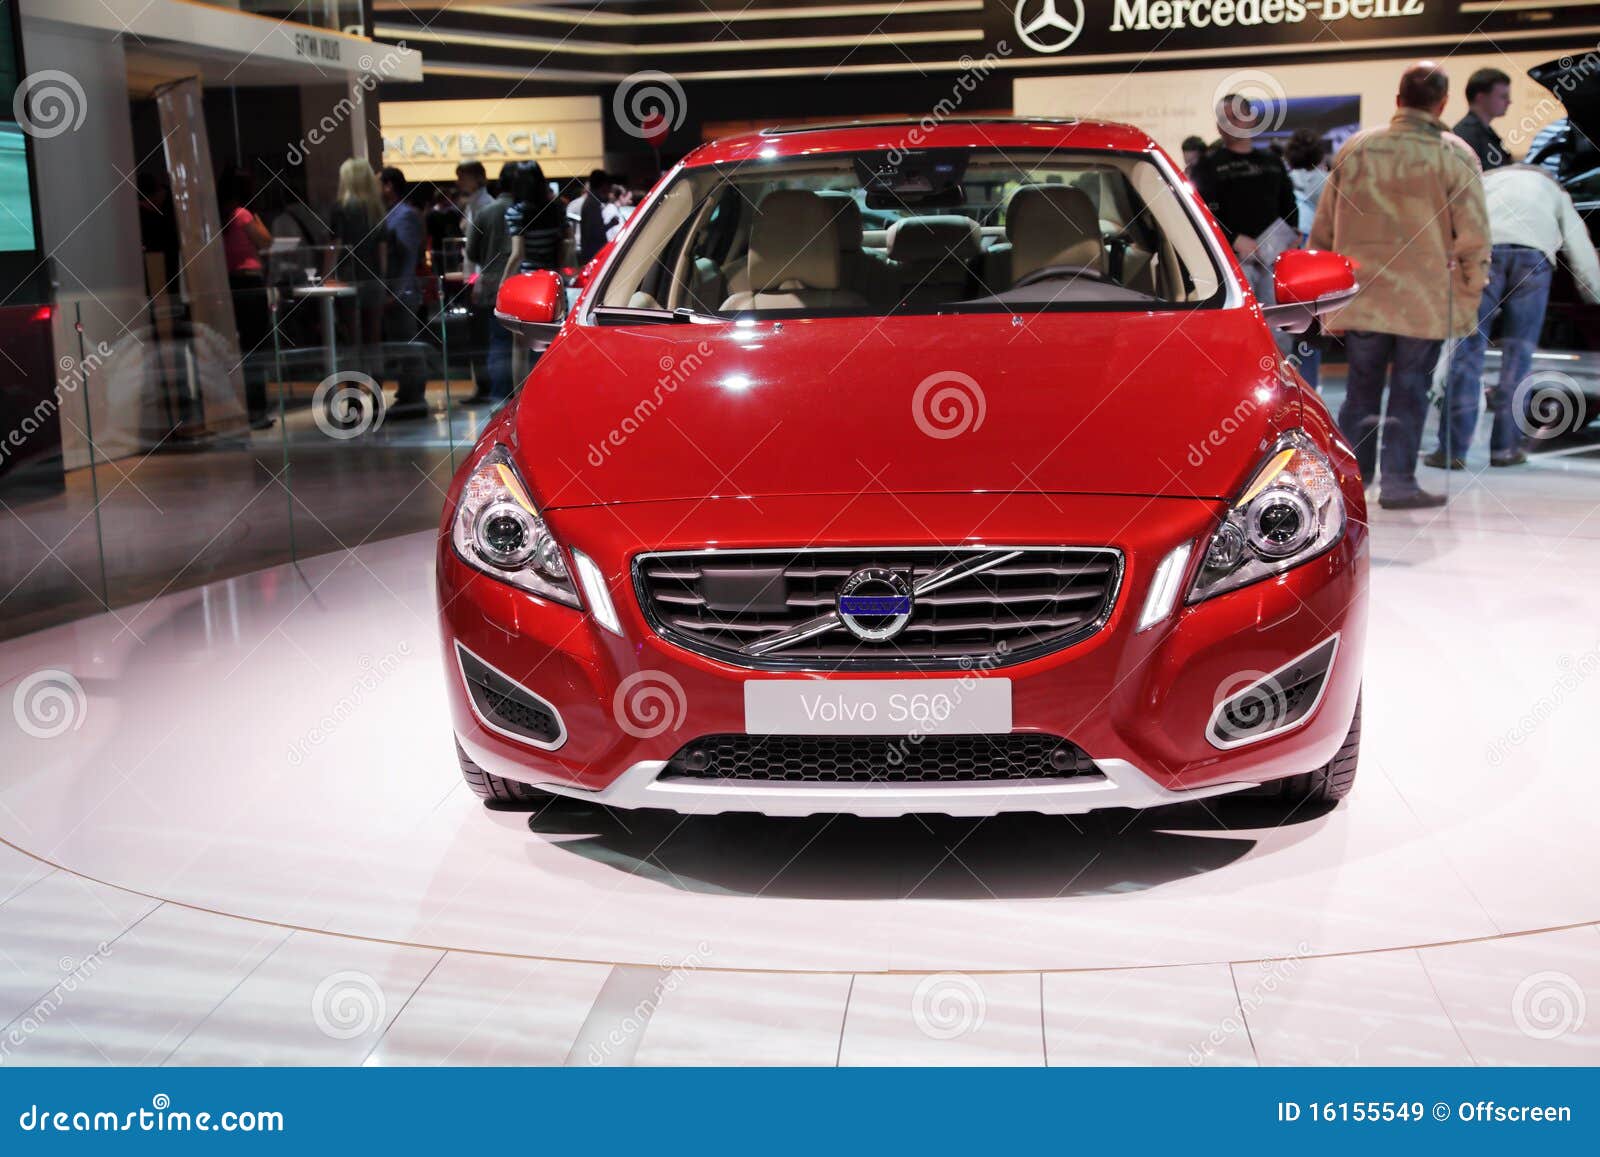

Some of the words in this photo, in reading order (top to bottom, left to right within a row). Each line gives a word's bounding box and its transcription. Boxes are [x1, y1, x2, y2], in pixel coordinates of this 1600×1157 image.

[1109, 0, 1425, 31] Mercedes-Benz
[383, 129, 557, 158] MAYBACH
[846, 601, 906, 611] VOLVO
[800, 694, 877, 721] Volvo
[888, 693, 951, 721] S60
